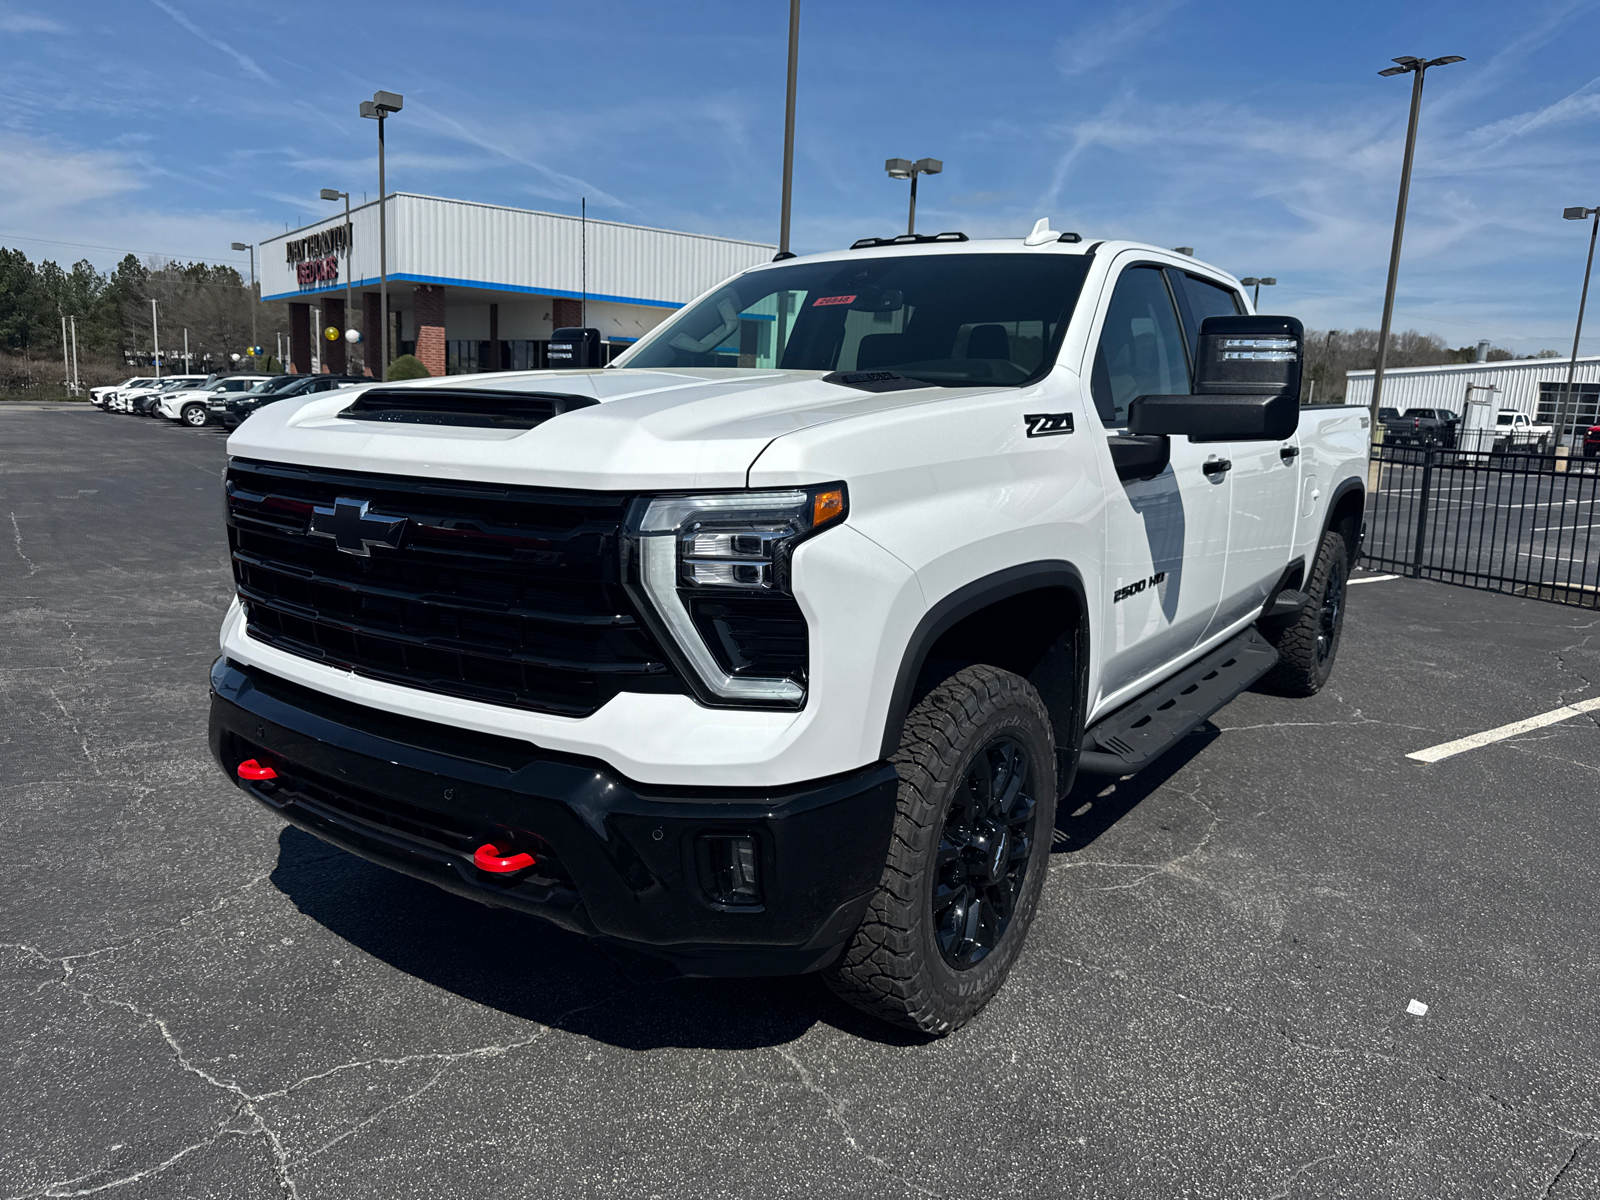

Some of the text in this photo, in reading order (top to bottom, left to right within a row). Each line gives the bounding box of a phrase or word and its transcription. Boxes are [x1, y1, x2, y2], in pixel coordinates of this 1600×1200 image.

[286, 239, 306, 263] JOHN
[297, 255, 336, 285] USED CARS
[818, 296, 850, 305] 26848
[1023, 412, 1075, 439] Z71
[1113, 571, 1165, 604] 2500 HD
